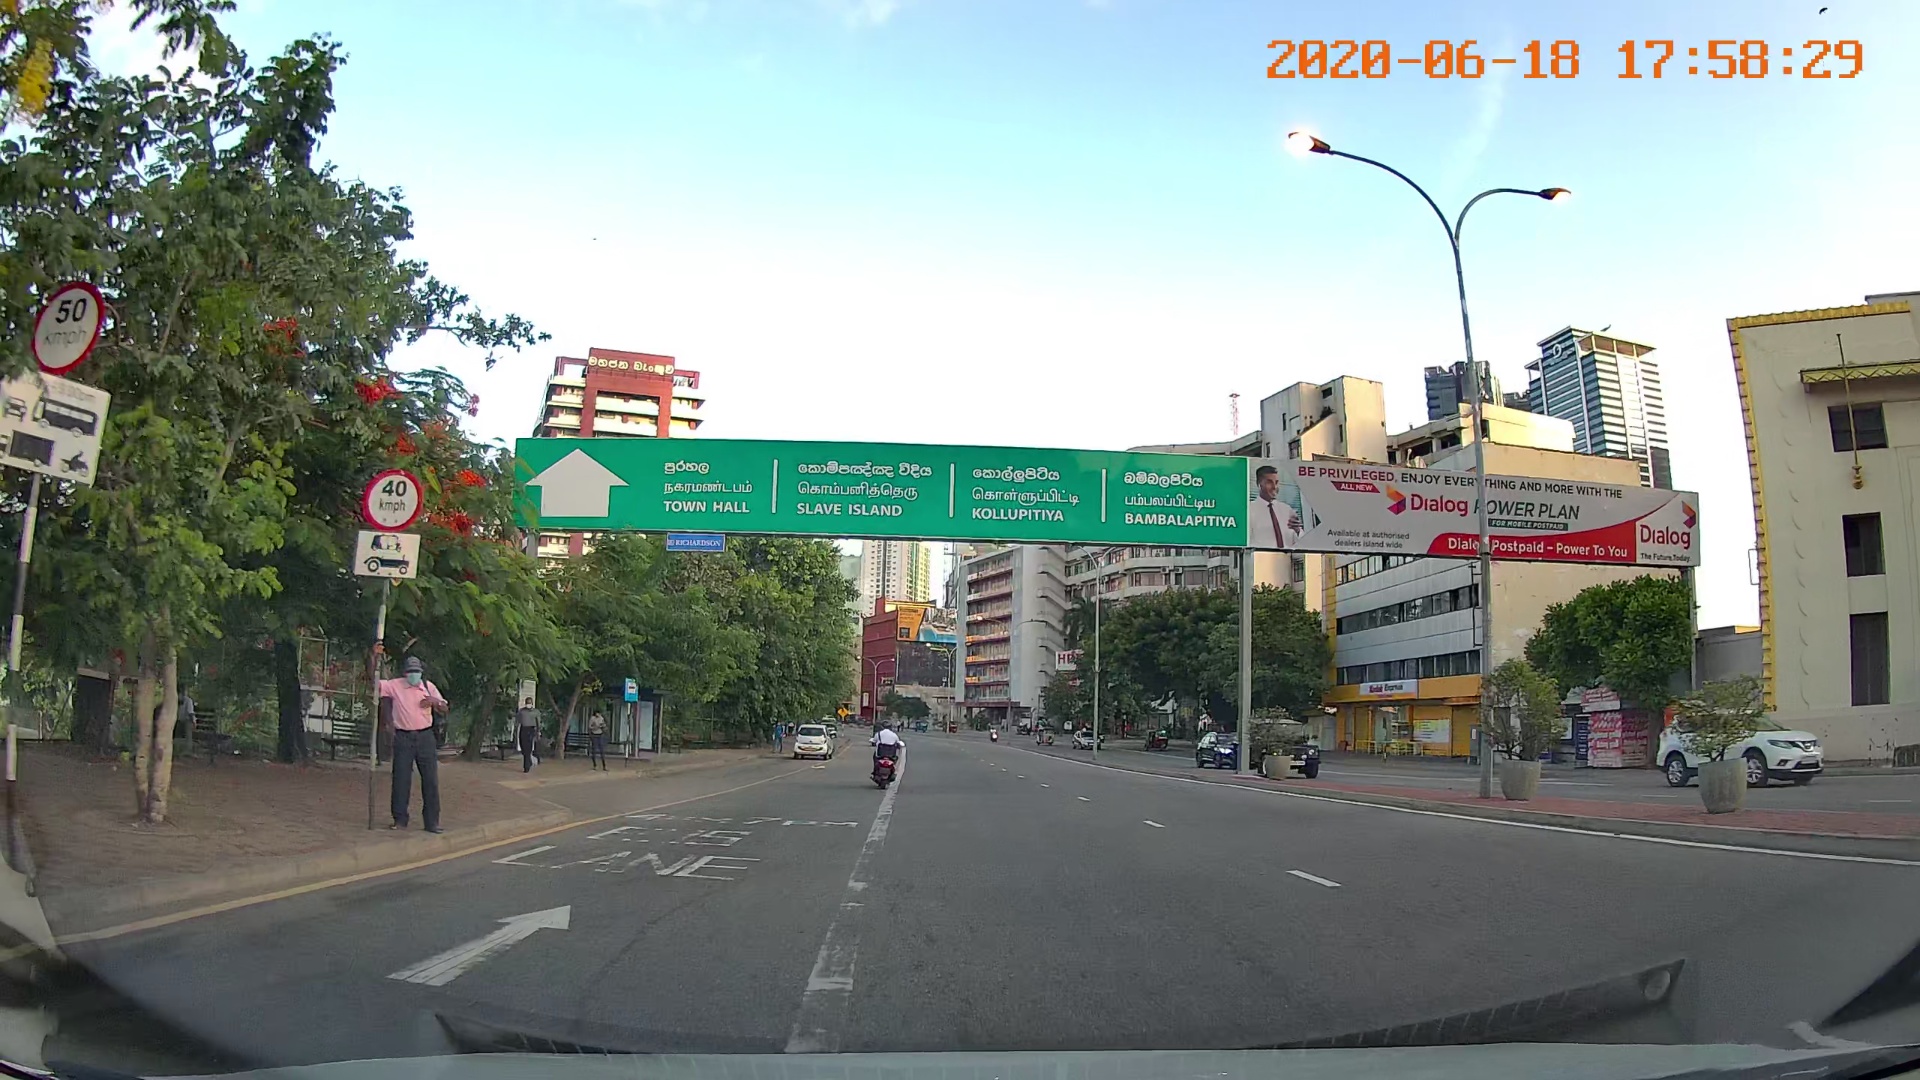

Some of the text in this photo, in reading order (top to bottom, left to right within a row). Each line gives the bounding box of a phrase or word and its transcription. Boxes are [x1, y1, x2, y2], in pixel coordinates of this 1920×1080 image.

[56, 298, 87, 324] 50
[382, 480, 407, 497] 40
[663, 480, 753, 494] நகரமண்டபம்
[1298, 466, 1622, 499] BE PRIVILEGED, ENJOY EVERTHING AND MORE WITH THE
[1341, 483, 1373, 492] ALL NEW
[798, 481, 918, 500] கொம்பனித்தெரு
[379, 498, 406, 514] kmph
[663, 501, 750, 513] TOWN HALL
[796, 502, 903, 516] SLAVE ISLAND
[1411, 494, 1468, 517] Dialog
[1538, 503, 1580, 520] PLAN
[972, 508, 1064, 521] KOLLUPITIYA
[1125, 513, 1237, 528] BAMBALAPITIYA
[1533, 522, 1564, 531] POSTPAID
[1328, 528, 1360, 539] Available
[1371, 531, 1410, 541] authorised
[1640, 524, 1691, 550] Dialog
[675, 539, 721, 547] RICHARDSON
[1335, 539, 1403, 549] dealers island wide
[1448, 537, 1480, 551] Dialo
[1491, 540, 1544, 555] Postpaid
[1556, 543, 1589, 556] Power
[1592, 545, 1605, 556] To
[1608, 546, 1628, 558] You
[1641, 552, 1651, 560] The
